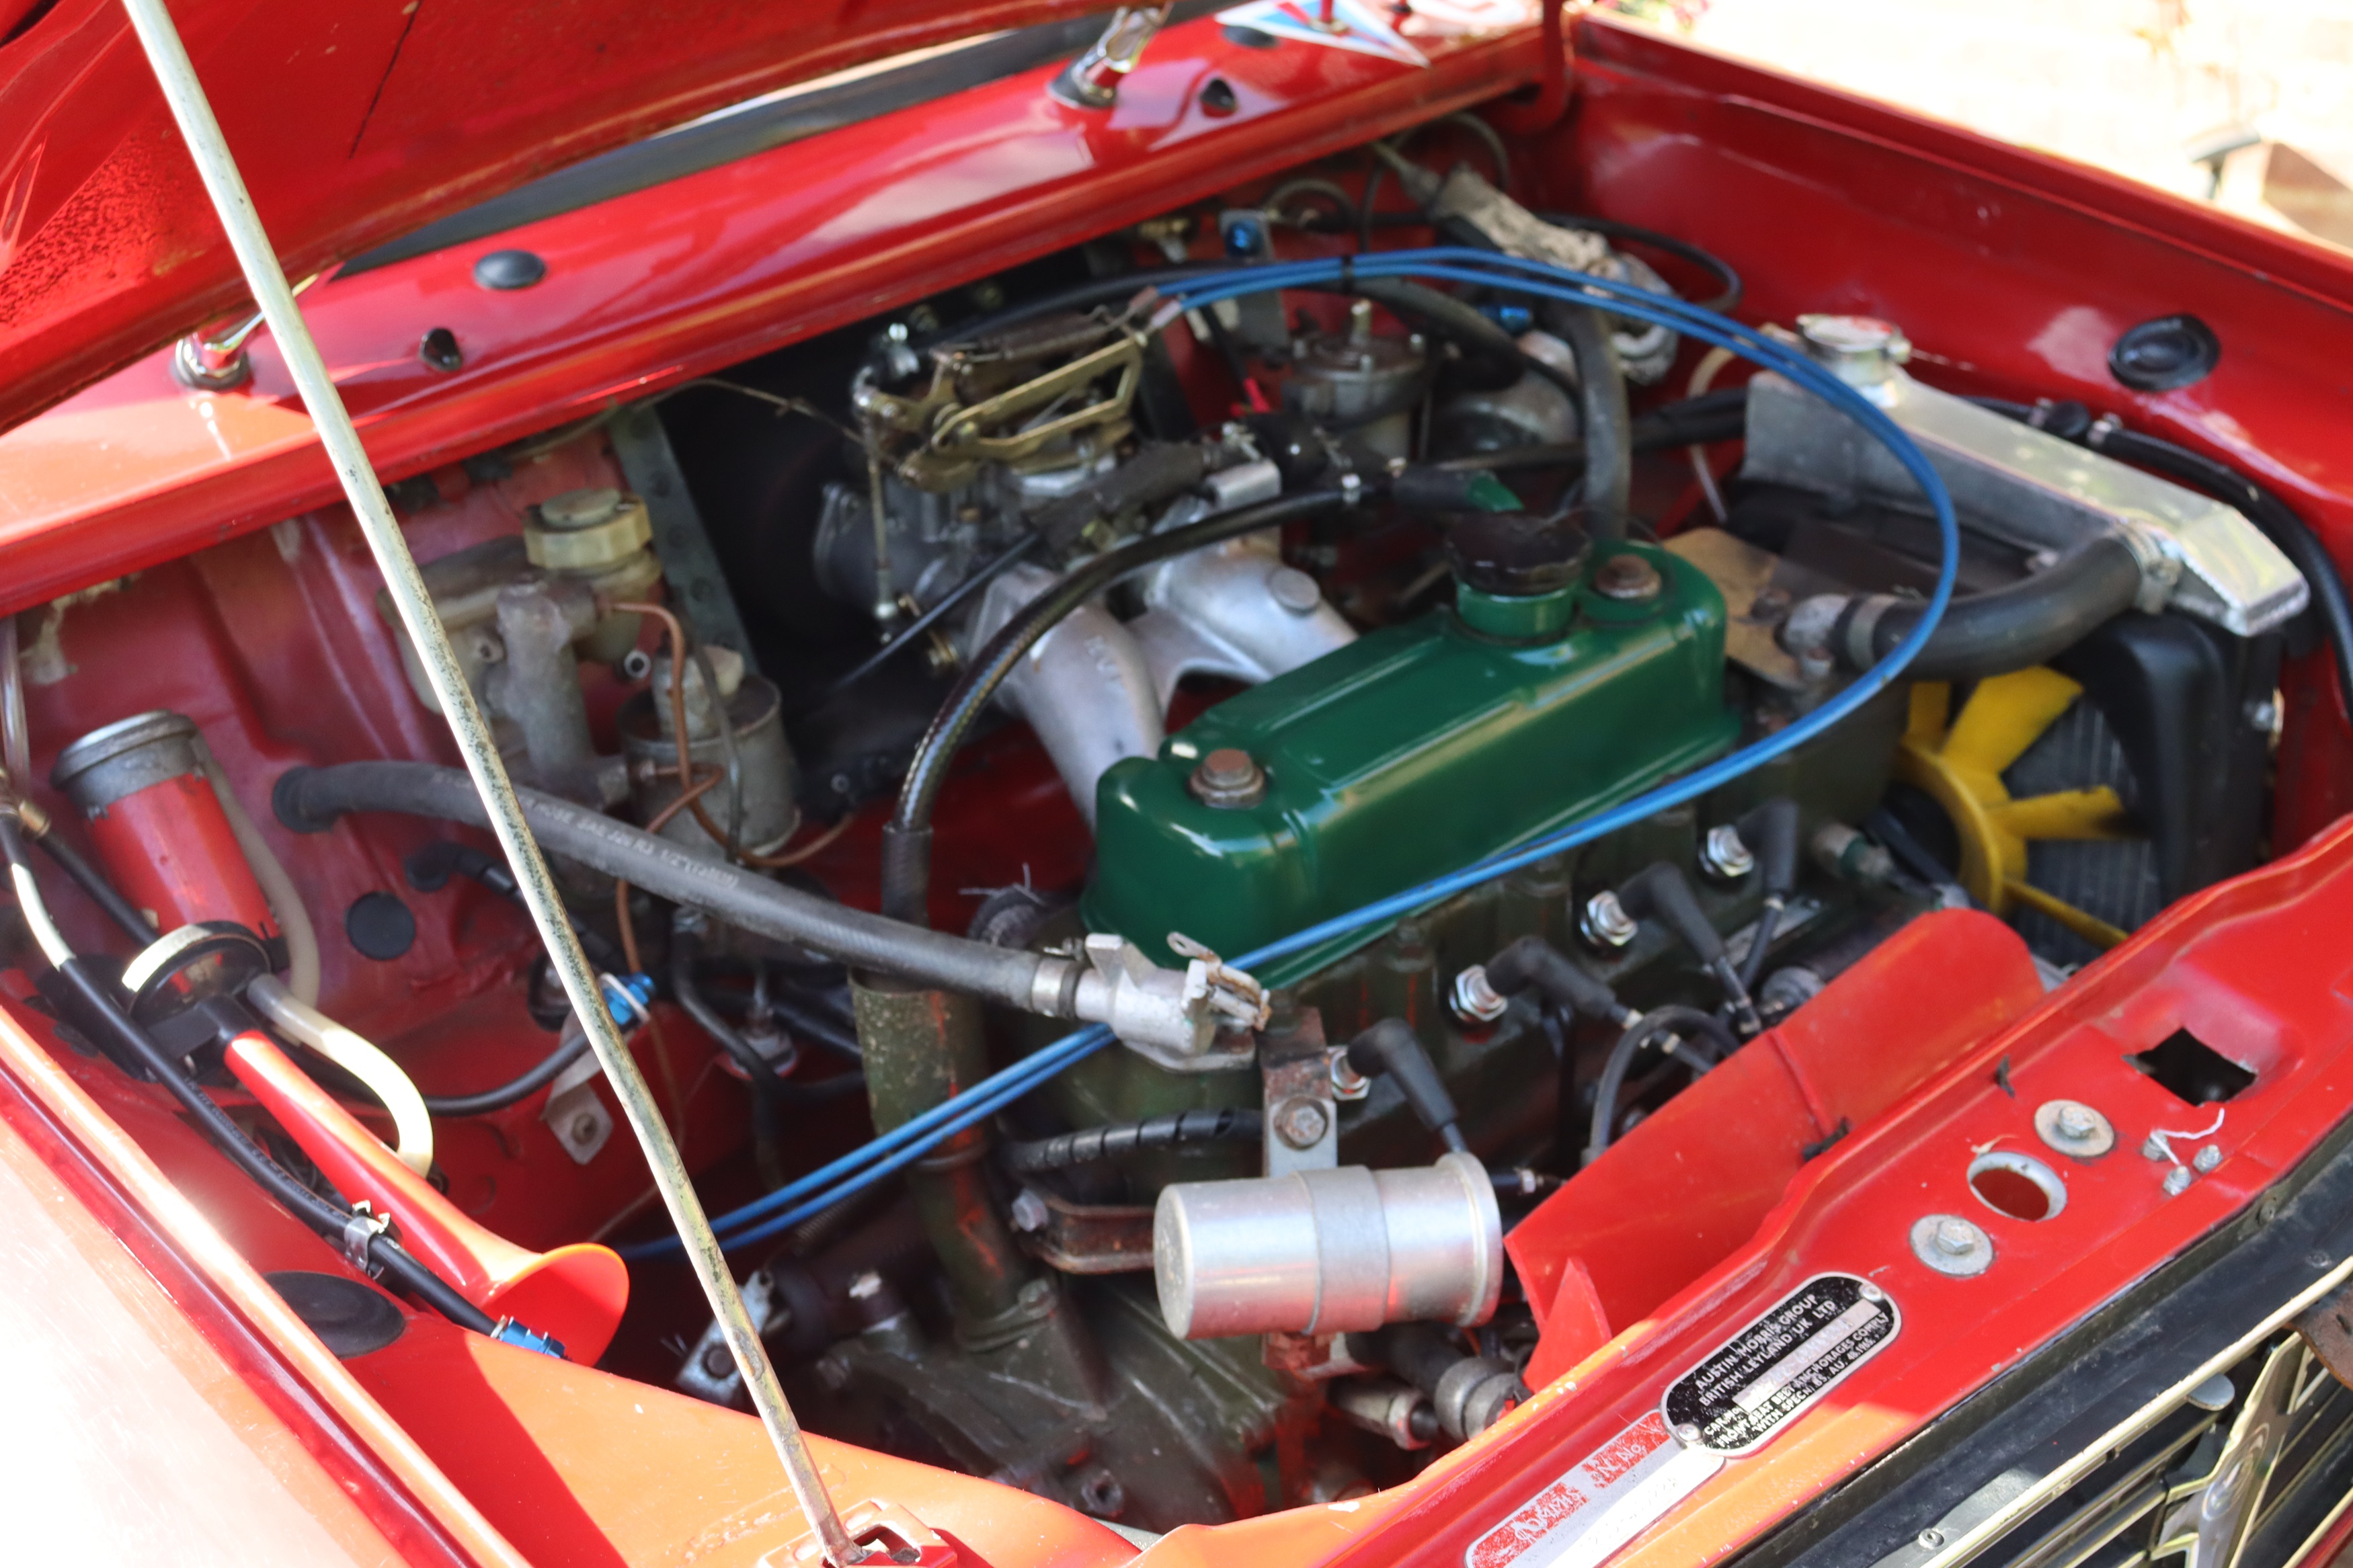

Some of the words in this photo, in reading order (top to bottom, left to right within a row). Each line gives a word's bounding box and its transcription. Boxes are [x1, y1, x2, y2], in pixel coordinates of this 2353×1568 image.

[1693, 1351, 1741, 1391] AUSTIN
[1737, 1320, 1781, 1358] MORRIS
[1778, 1292, 1818, 1327] GROUP
[1698, 1370, 1743, 1407] BRITISH
[1742, 1331, 1794, 1375] LEYLAND
[1790, 1316, 1813, 1337] UK
[1811, 1298, 1836, 1321] LTD
[1716, 1418, 1752, 1448] FRONT
[1747, 1401, 1773, 1425] SEAT
[1771, 1383, 1796, 1406] BELT
[1794, 1337, 1855, 1388] ANCHORAGES
[1853, 1312, 1889, 1343] COMPLY
[1753, 1407, 1784, 1434] WITH
